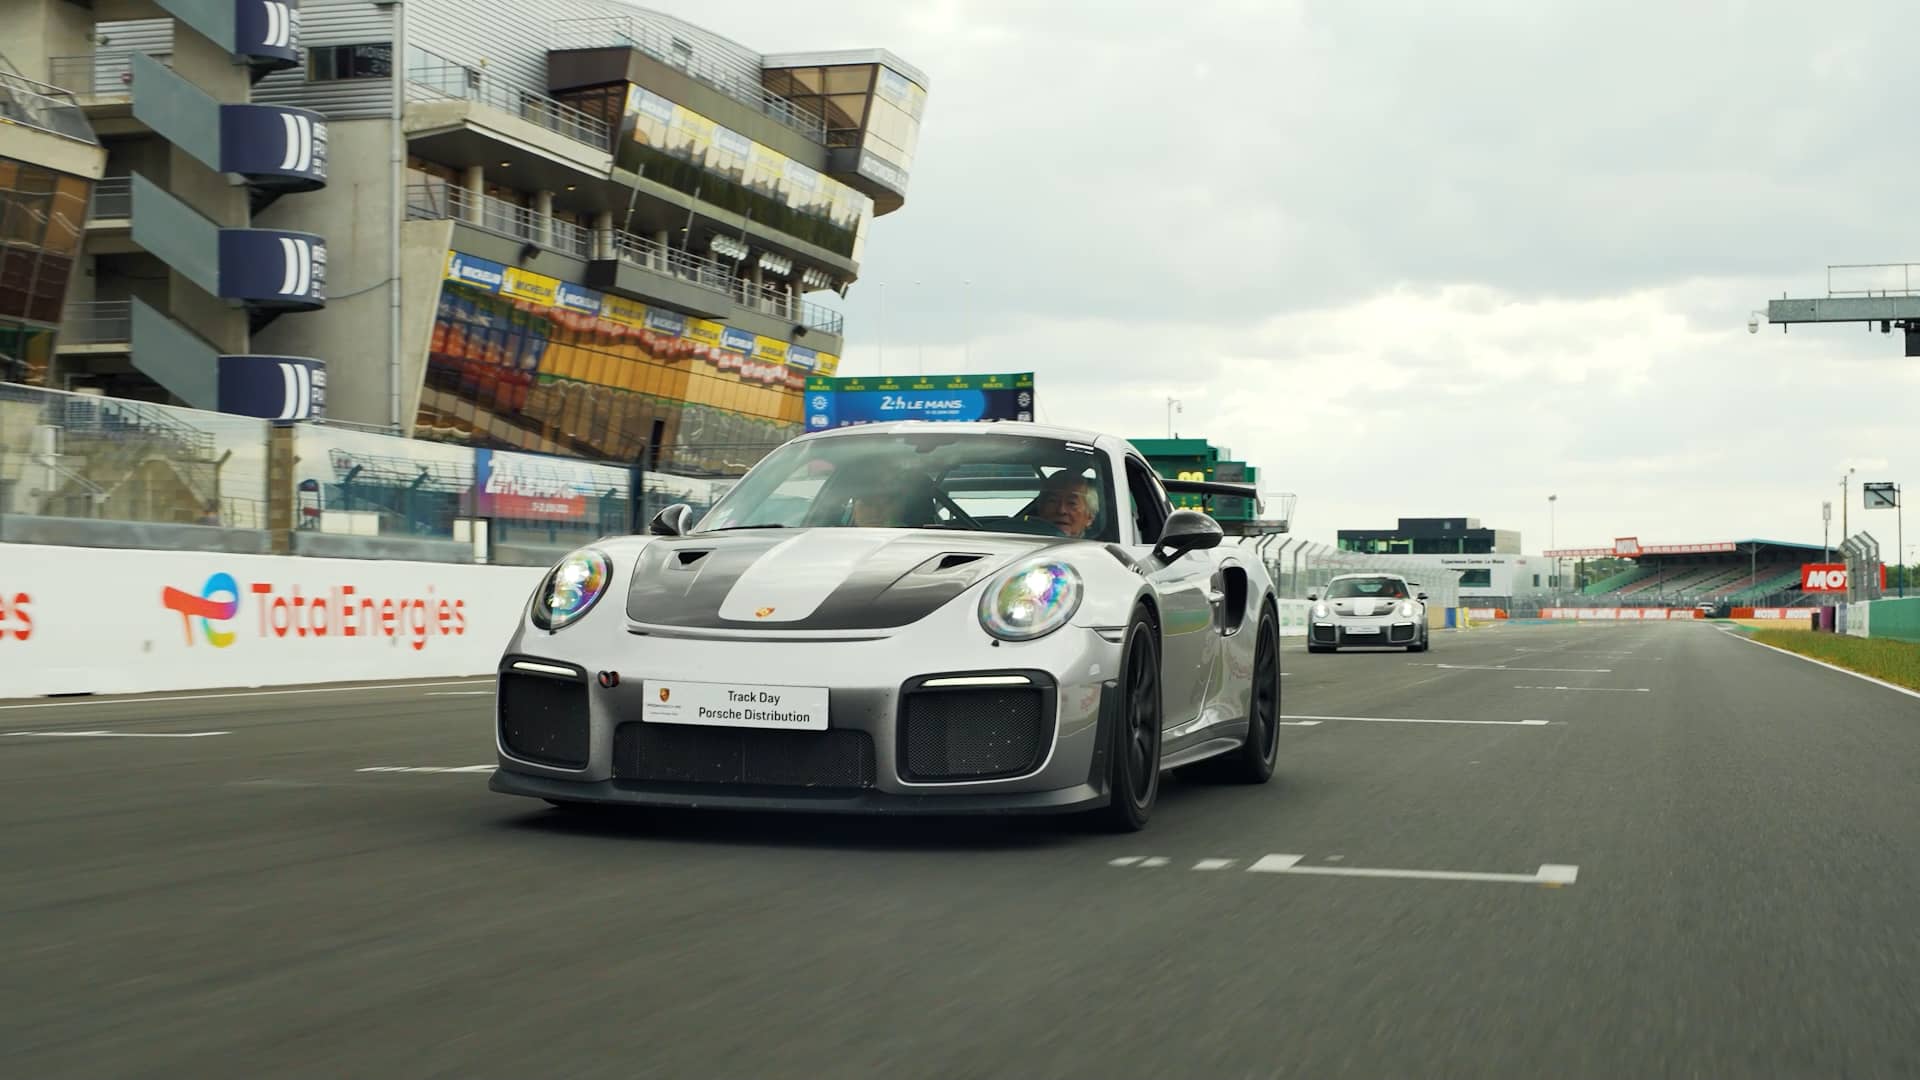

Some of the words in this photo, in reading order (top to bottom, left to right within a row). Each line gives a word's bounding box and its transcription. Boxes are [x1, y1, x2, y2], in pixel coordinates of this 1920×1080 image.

[906, 400, 925, 410] LE
[924, 399, 963, 410] MANS
[251, 583, 467, 650] TotalEnergies
[728, 690, 756, 702] Track
[759, 691, 781, 706] Day
[698, 706, 742, 720] Porsche
[744, 708, 810, 722] Distribution
